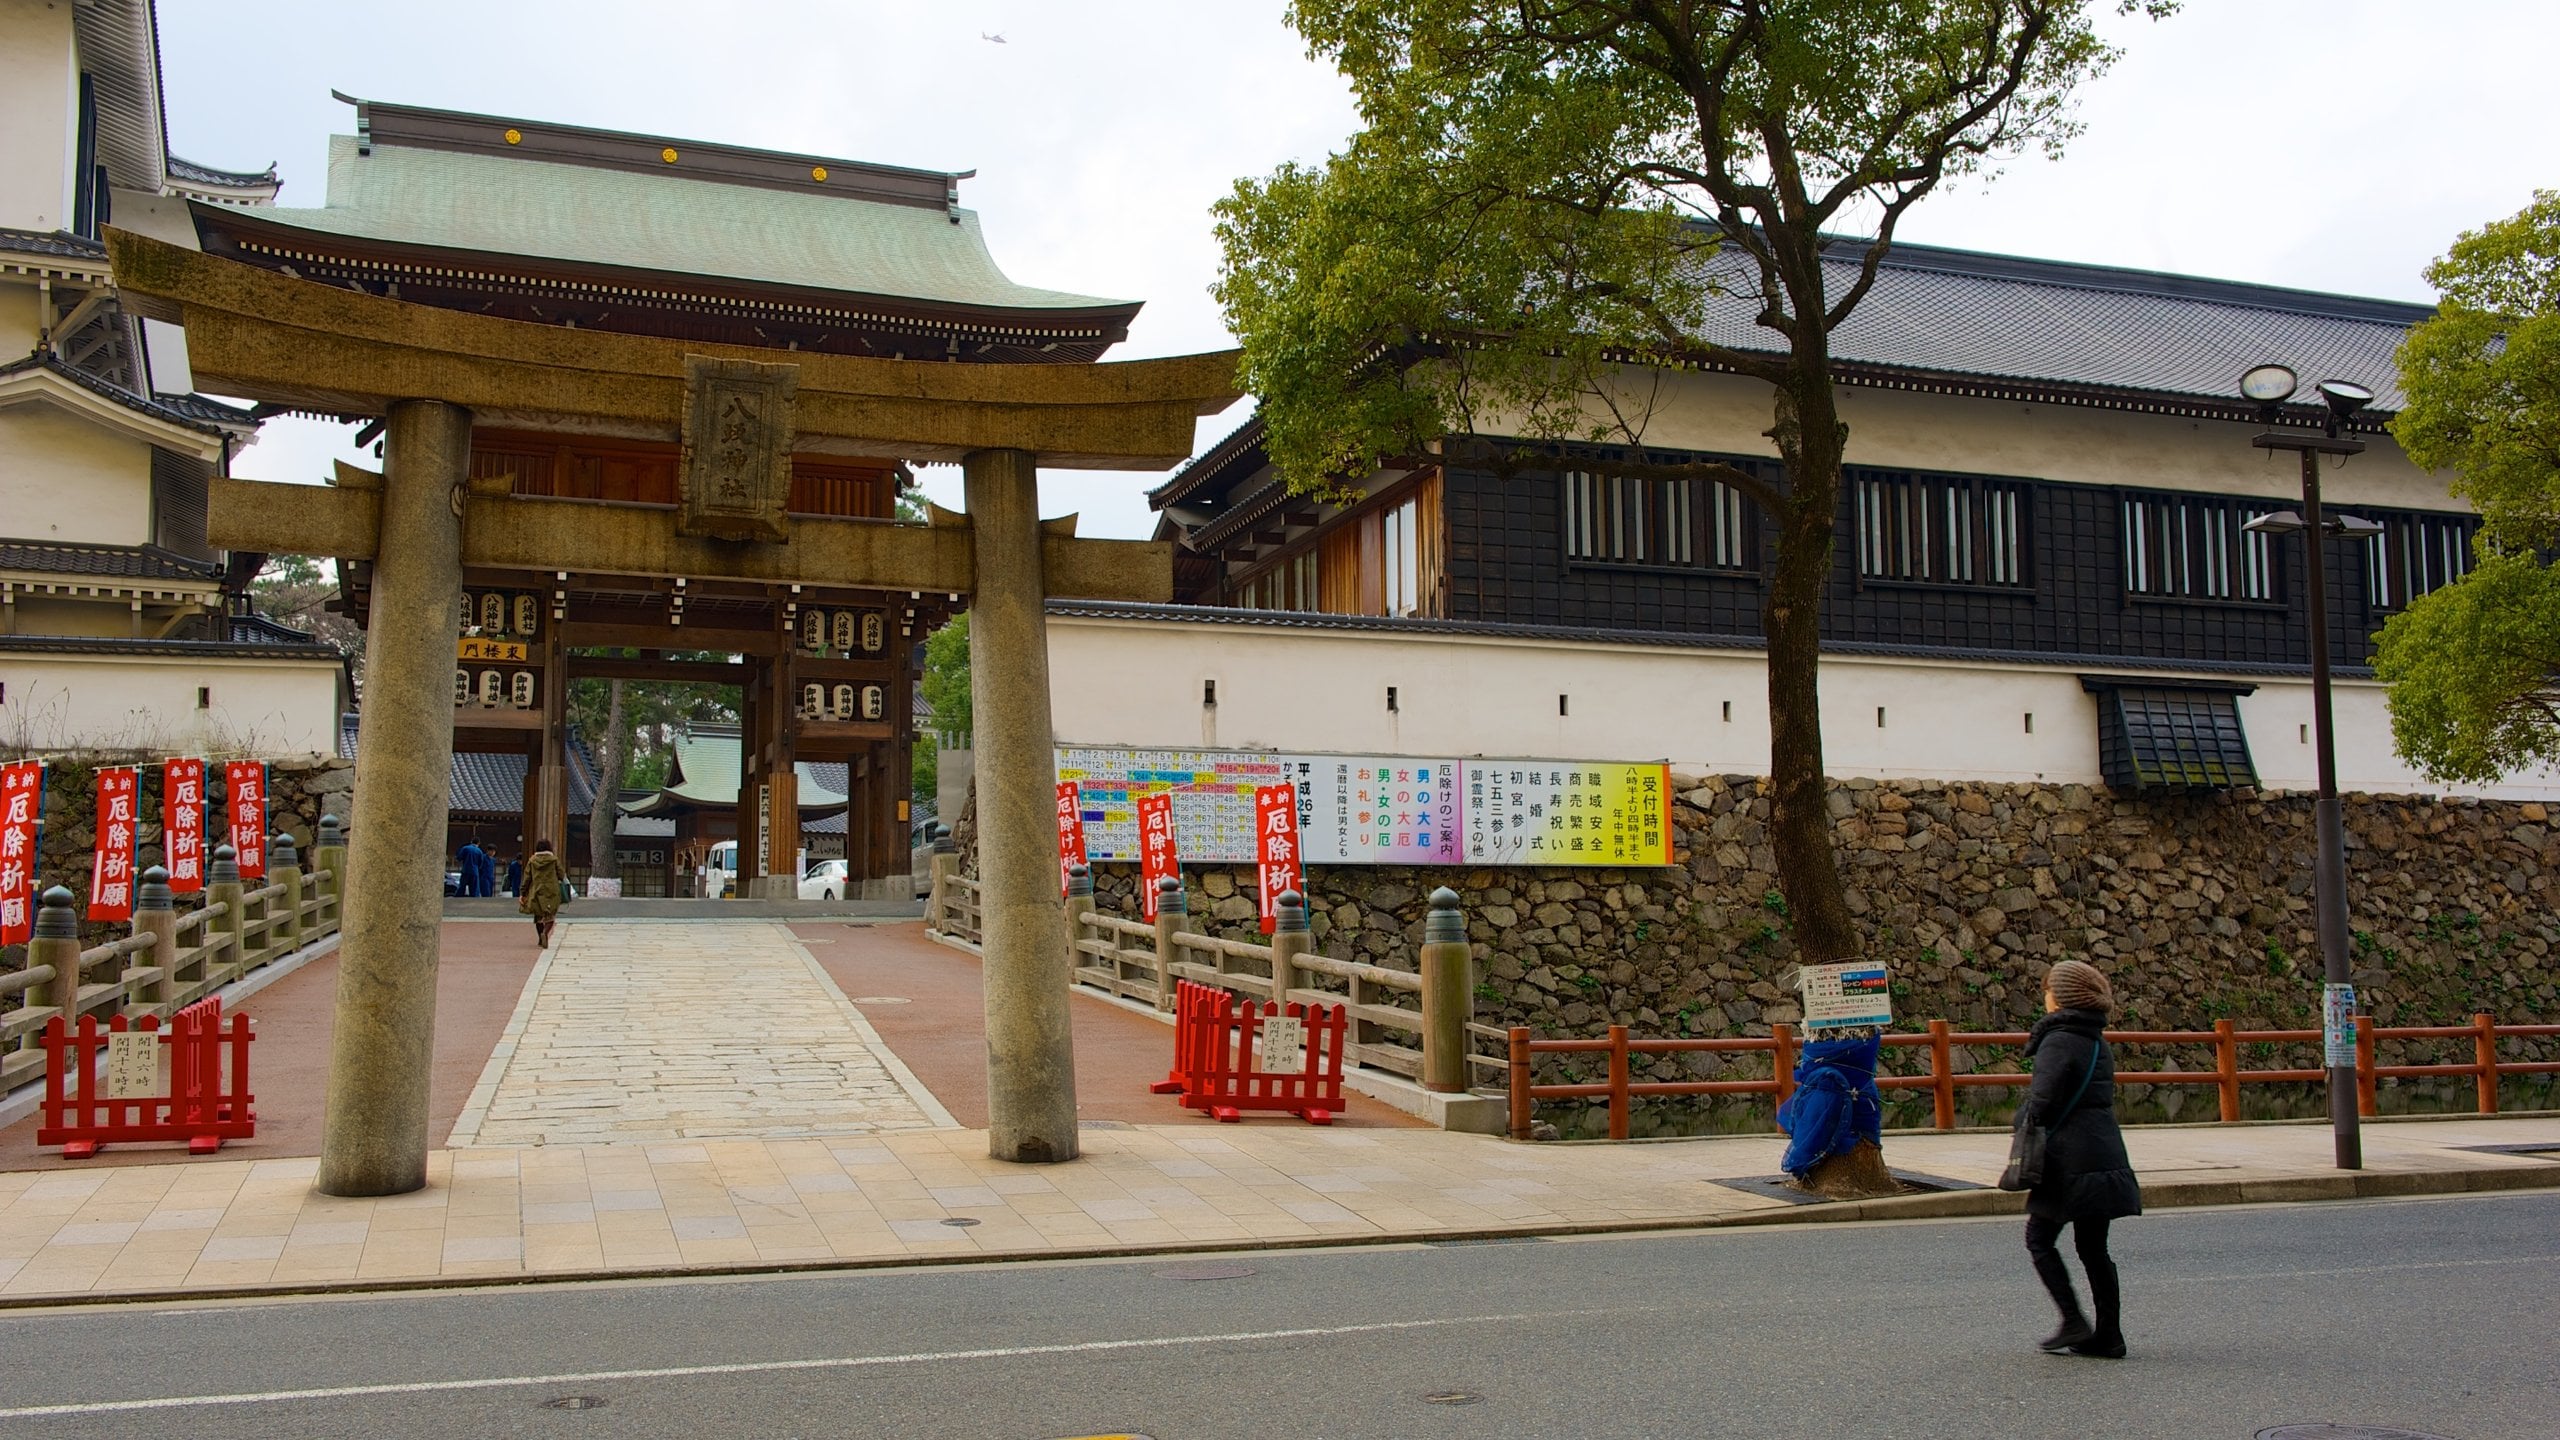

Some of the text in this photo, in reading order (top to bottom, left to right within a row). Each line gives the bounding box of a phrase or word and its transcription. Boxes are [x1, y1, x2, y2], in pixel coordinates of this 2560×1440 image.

[1071, 760, 1079, 768] 11
[1092, 761, 1100, 769] 12
[1181, 763, 1189, 771] 16
[1267, 765, 1276, 773] 20
[1113, 772, 1122, 780] 23
[1202, 774, 1211, 782] 27
[1224, 775, 1233, 783] 28
[1245, 775, 1255, 783] 29
[1202, 784, 1211, 792] 37
[1224, 784, 1233, 792] 38
[1245, 784, 1254, 792] 39
[1268, 755, 1276, 763] 10
[1297, 762, 1313, 828] 平成26年
[174, 780, 199, 880] 厄除祈願
[237, 780, 260, 867] 厄除祈願
[1114, 823, 1122, 831] 73
[1202, 794, 1211, 802] 47
[1224, 795, 1233, 803] 48
[1245, 795, 1254, 803] 49
[1224, 805, 1233, 813] 58
[1337, 764, 1348, 857] 還暦以降は男女とも
[1357, 768, 1371, 845] お礼参り
[1397, 769, 1411, 847] 女の大厄
[1417, 769, 1431, 847] 男の大厄
[1439, 764, 1453, 856] 厄除けのご案内
[1490, 770, 1504, 849] 七五三参り
[1510, 771, 1524, 849] 初宮参り
[1529, 771, 1543, 850] 結婚式
[1550, 772, 1563, 850] 長寿祝い
[1569, 772, 1584, 851] 商売繁盛
[1589, 772, 1603, 851] 職域安全
[1613, 808, 1625, 859] 年中無休
[1626, 767, 1640, 861] 八時半より四時半まで
[1643, 776, 1659, 847] 受付時間
[0, 792, 30, 927] 厄除祈願
[100, 794, 131, 907] 厄除祈願
[652, 852, 662, 863] 3
[1091, 833, 1100, 841] 82
[1225, 835, 1233, 843] 88
[1091, 843, 1100, 851] 92
[1246, 845, 1255, 853] 99
